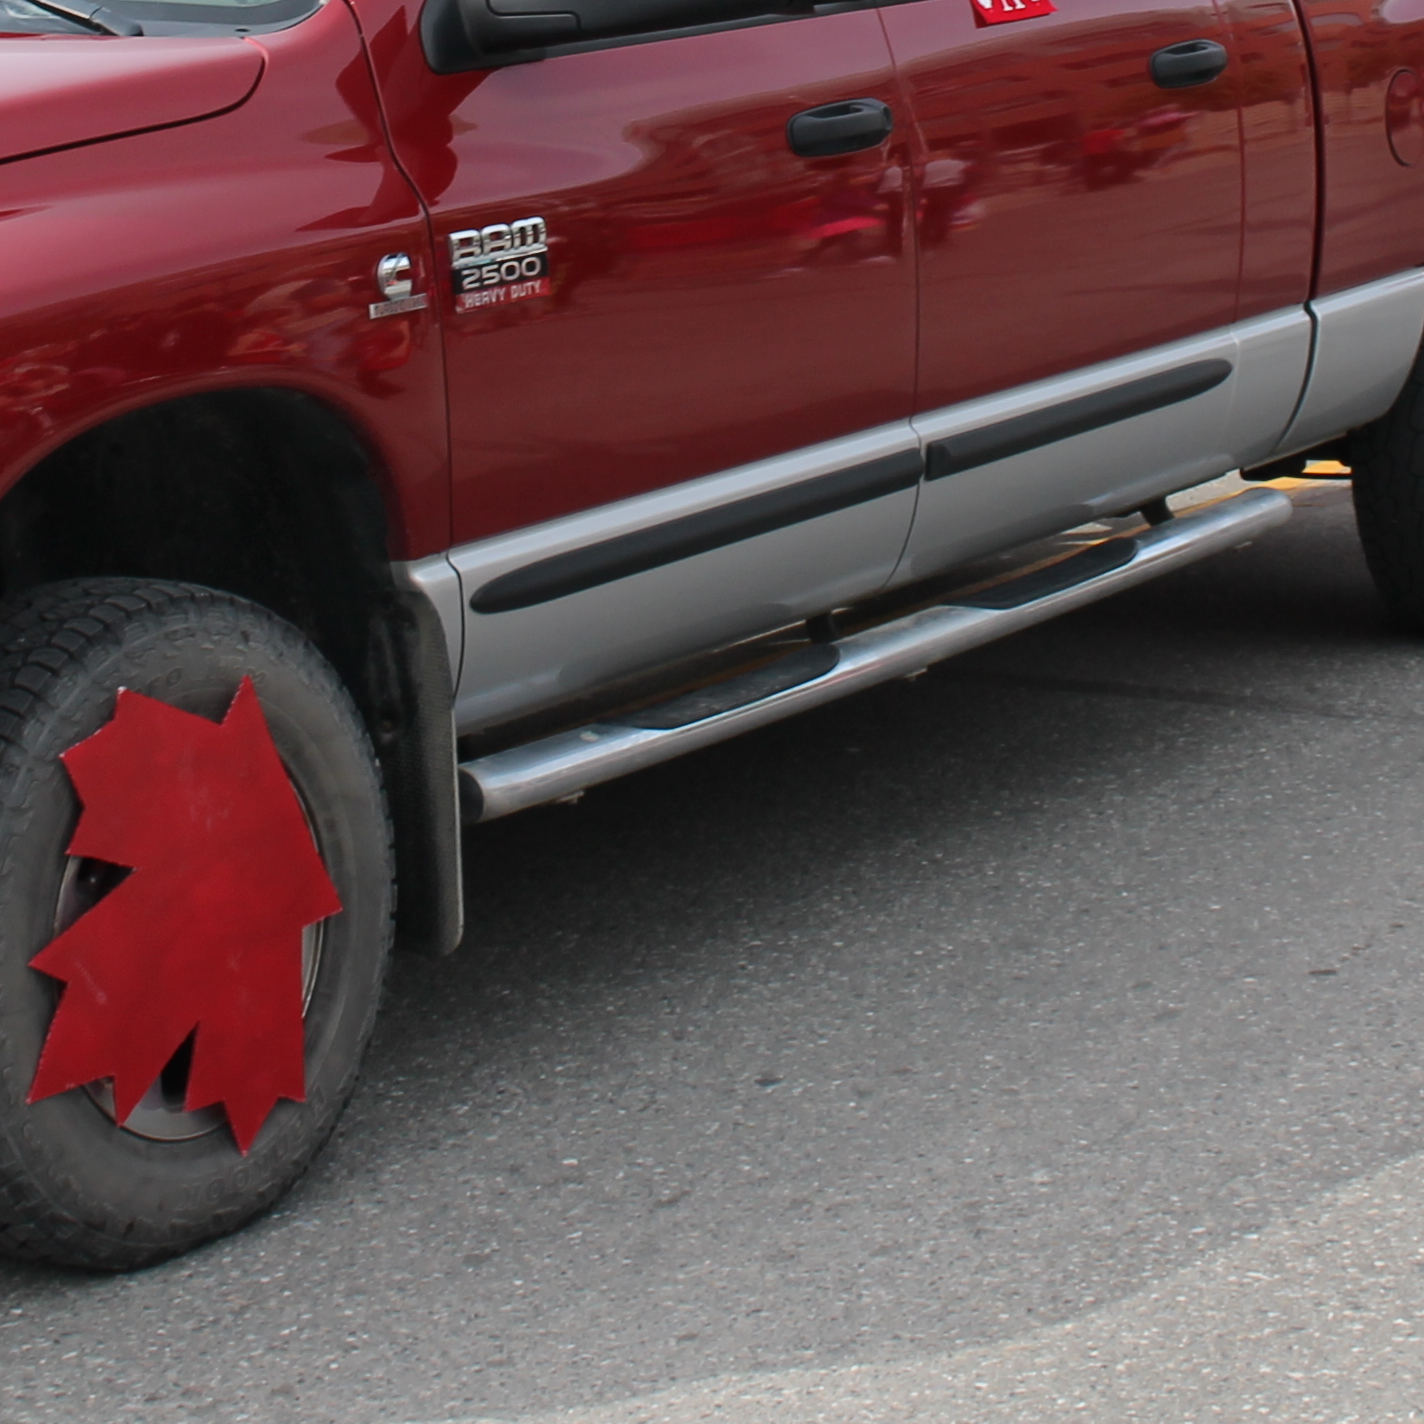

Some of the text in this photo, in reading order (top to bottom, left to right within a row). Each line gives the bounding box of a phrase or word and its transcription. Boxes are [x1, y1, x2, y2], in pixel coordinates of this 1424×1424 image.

[449, 216, 548, 268] RAM
[461, 256, 541, 290] 2500
[464, 279, 542, 309] HEAVY DUTY
